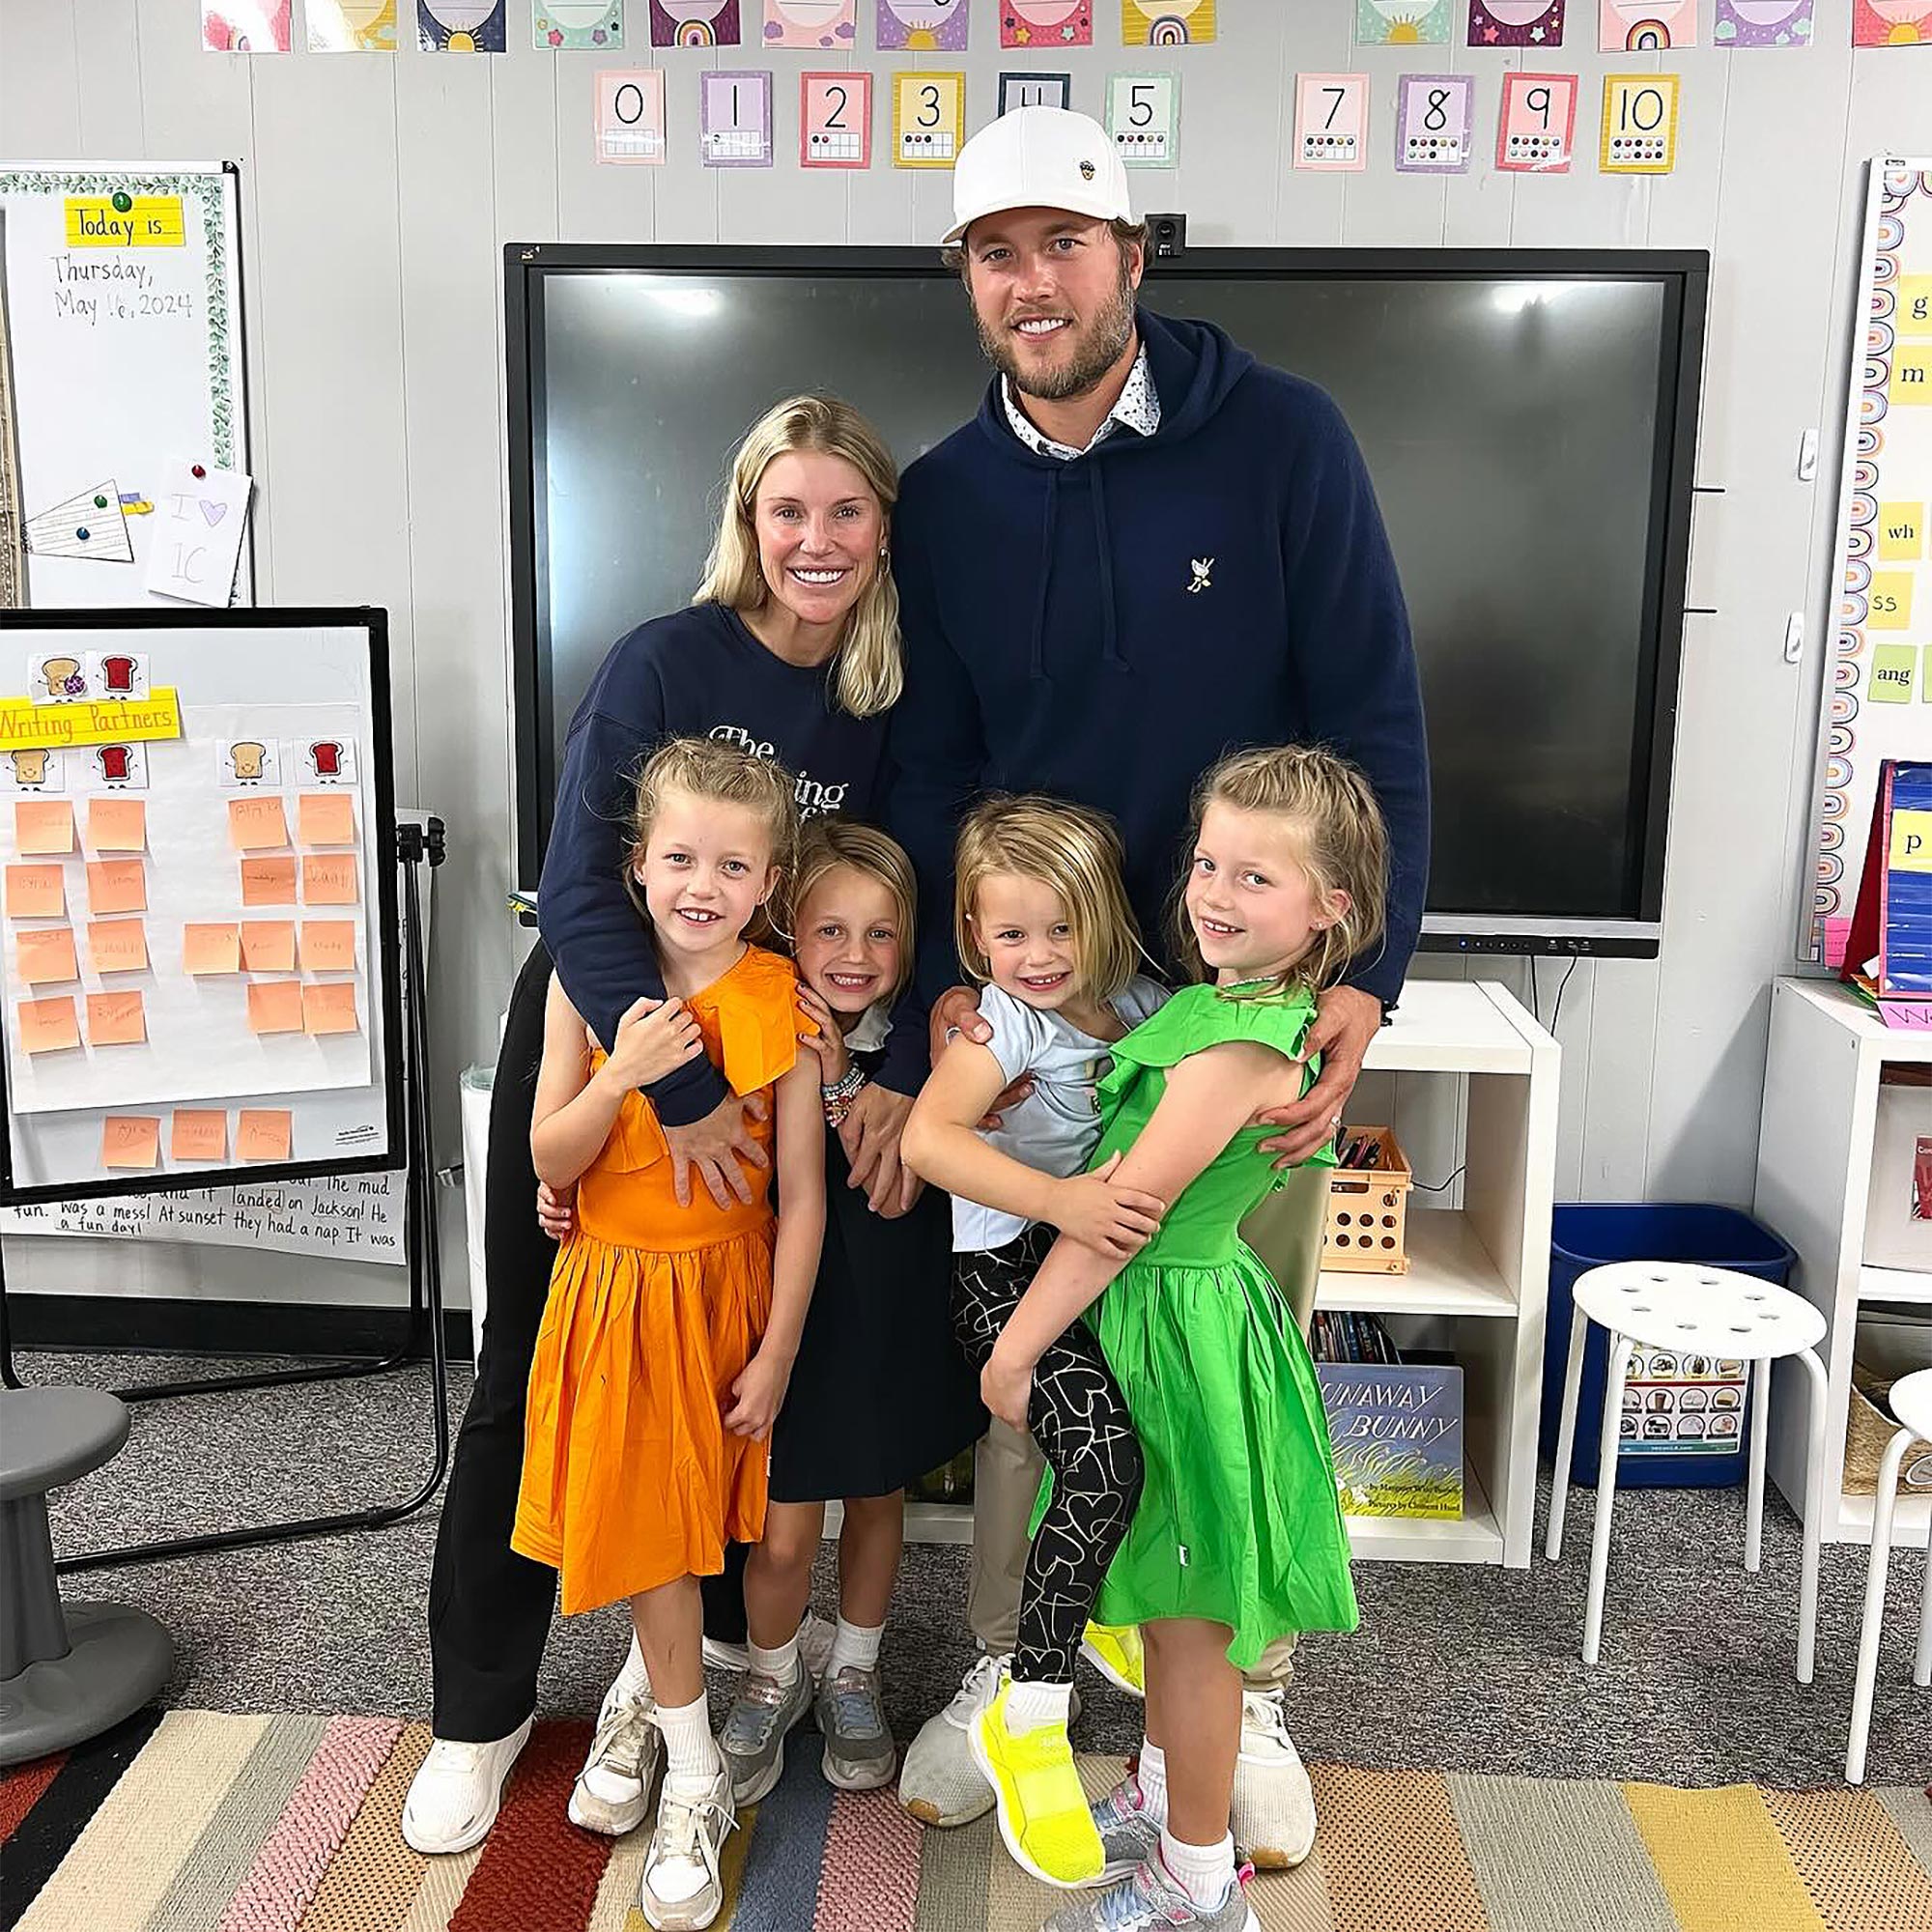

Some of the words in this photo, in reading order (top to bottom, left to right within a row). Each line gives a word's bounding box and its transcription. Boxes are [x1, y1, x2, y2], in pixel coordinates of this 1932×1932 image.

[614, 83, 644, 125] 0
[732, 84, 738, 127] 1
[824, 86, 848, 128] 2
[917, 85, 941, 128] 3
[1128, 85, 1155, 127] 5
[1321, 88, 1346, 130] 7
[1424, 89, 1451, 130] 8
[1526, 88, 1550, 129] 9
[1621, 89, 1663, 131] 10
[75, 209, 133, 245] Today
[148, 217, 162, 234] is
[50, 253, 154, 289] Thursday,
[55, 289, 98, 326] May
[138, 293, 192, 319] 2024
[1912, 296, 1928, 320] g
[1901, 367, 1924, 383] m
[1888, 524, 1914, 539] wh
[1877, 668, 1911, 686] ang
[89, 702, 172, 732] Partners
[794, 770, 849, 810] ing
[1905, 834, 1922, 854] p
[233, 1185, 282, 1208] landed
[289, 1199, 302, 1210] on
[311, 1194, 365, 1220] Jackson!
[371, 1203, 387, 1223] He
[358, 1175, 390, 1196] mud
[61, 1219, 70, 1229] a
[78, 1216, 104, 1231] fun
[112, 1220, 141, 1236] day!
[96, 1205, 104, 1216] a
[114, 1203, 151, 1225] mess!
[159, 1206, 175, 1222] At
[178, 1207, 226, 1225] sunset
[233, 1210, 262, 1239] they
[268, 1212, 296, 1235] had
[299, 1225, 308, 1236] a
[345, 1227, 362, 1242] It
[370, 1235, 395, 1246] was
[1321, 1382, 1443, 1414] UNAWAY
[1343, 1414, 1459, 1447] BUNNY
